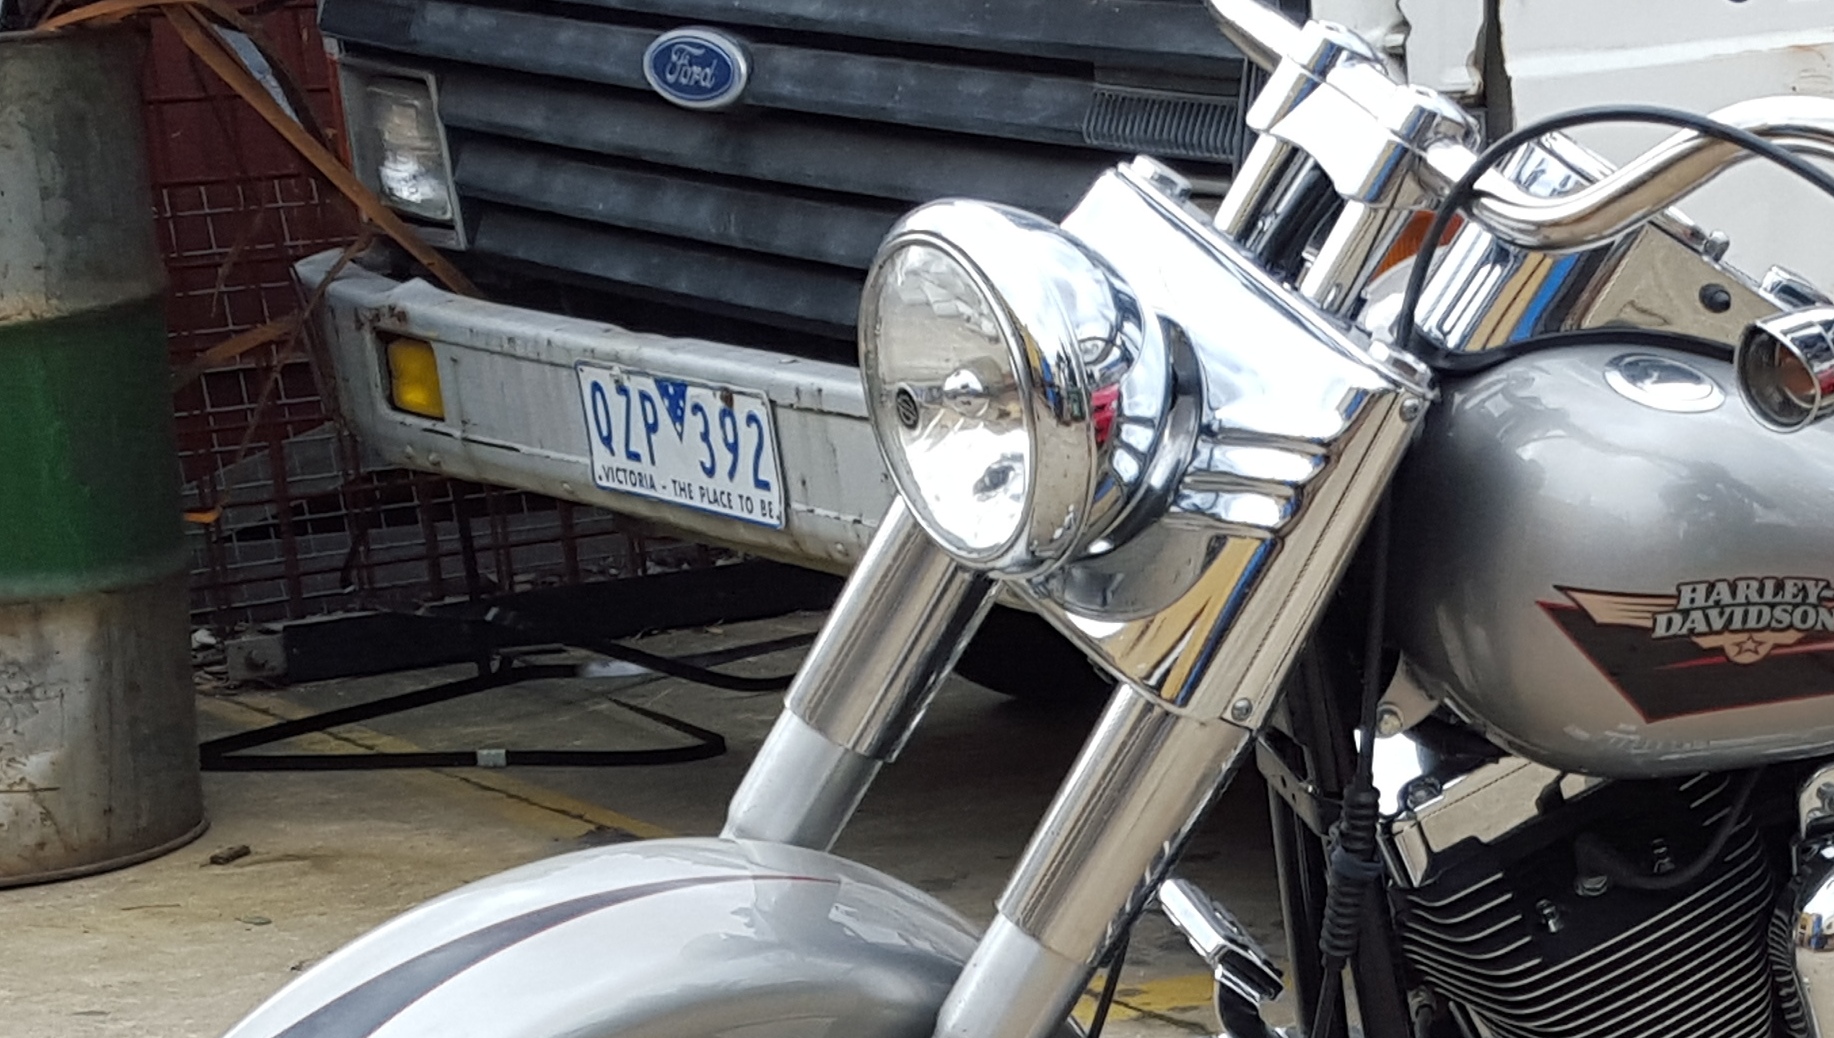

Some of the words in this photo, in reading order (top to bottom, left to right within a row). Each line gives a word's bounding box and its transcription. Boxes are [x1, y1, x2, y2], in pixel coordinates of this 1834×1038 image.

[665, 44, 718, 88] Ford
[591, 380, 659, 466] QZP
[691, 402, 772, 492] 392
[602, 465, 657, 491] VICTORIA
[671, 479, 695, 500] THE
[699, 485, 734, 511] PLACE
[738, 495, 755, 515] TO
[760, 500, 774, 519] BE
